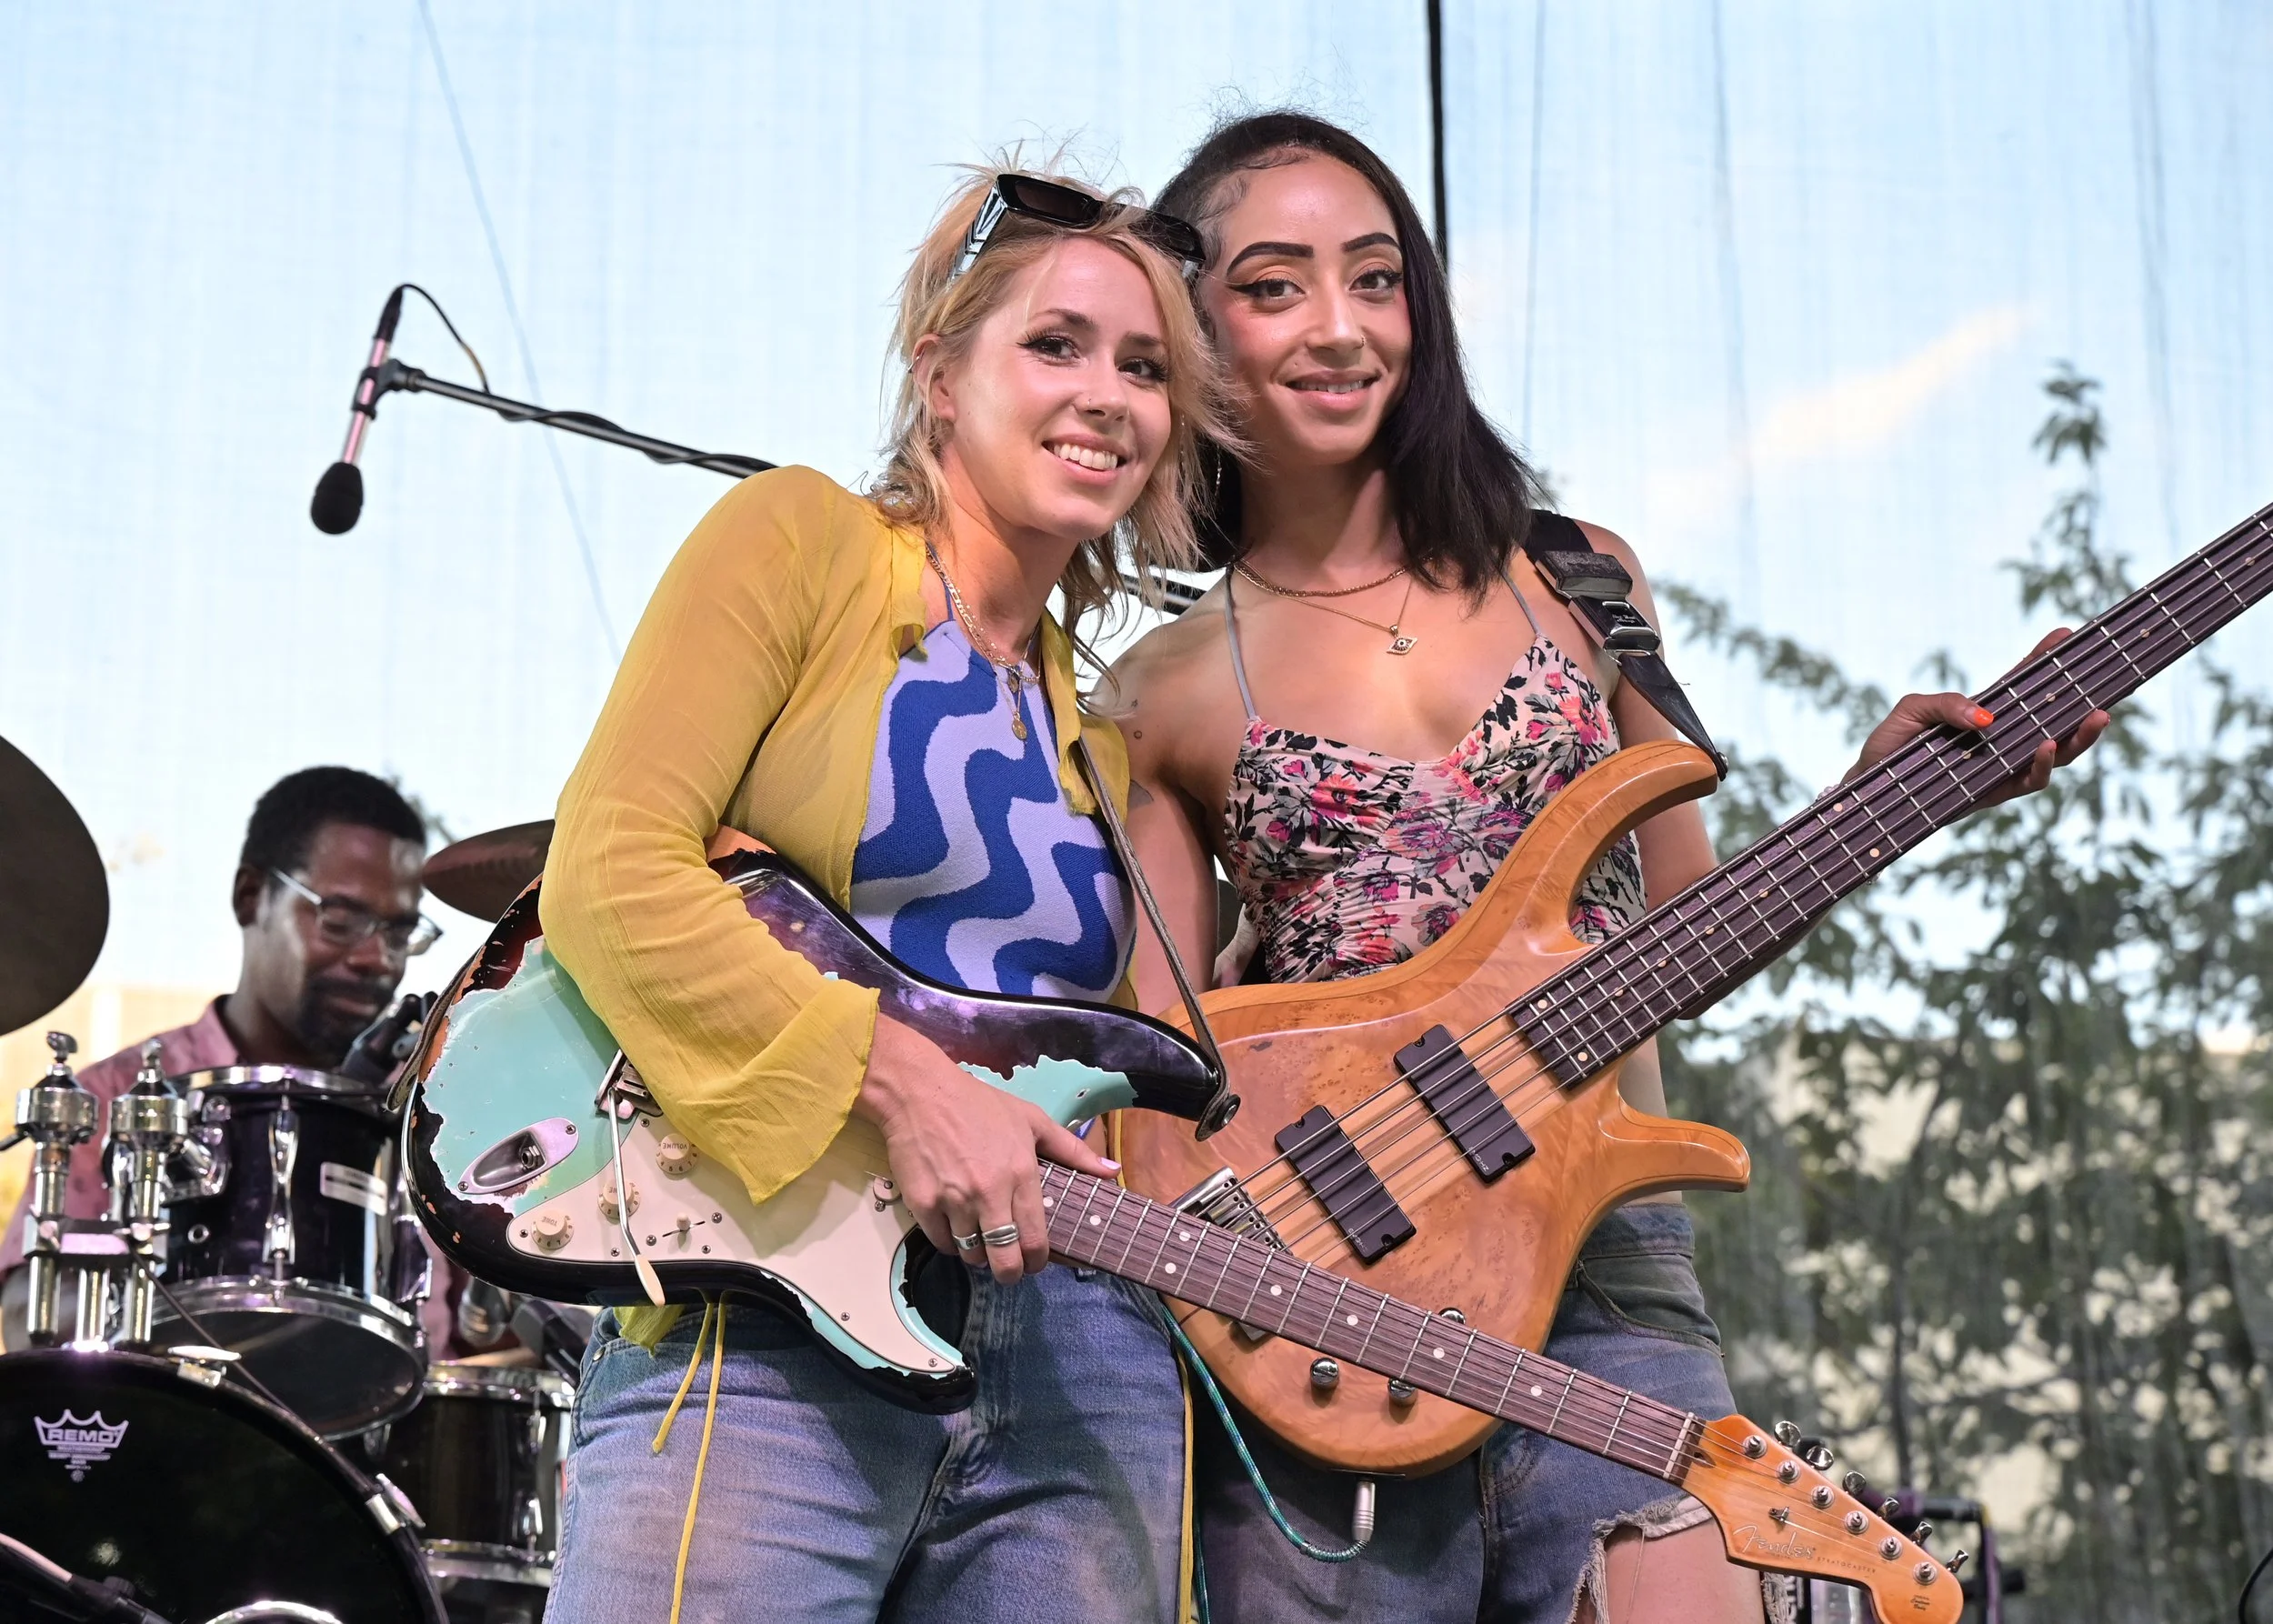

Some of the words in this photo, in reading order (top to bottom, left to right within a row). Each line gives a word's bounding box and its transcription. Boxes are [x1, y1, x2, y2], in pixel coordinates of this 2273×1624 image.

[662, 1142, 688, 1150] VOLUME
[541, 1216, 558, 1227] TONE
[47, 1428, 115, 1443] REMO
[1732, 1525, 1813, 1559] Fender
[1817, 1556, 1877, 1574] STRATOCASTER
